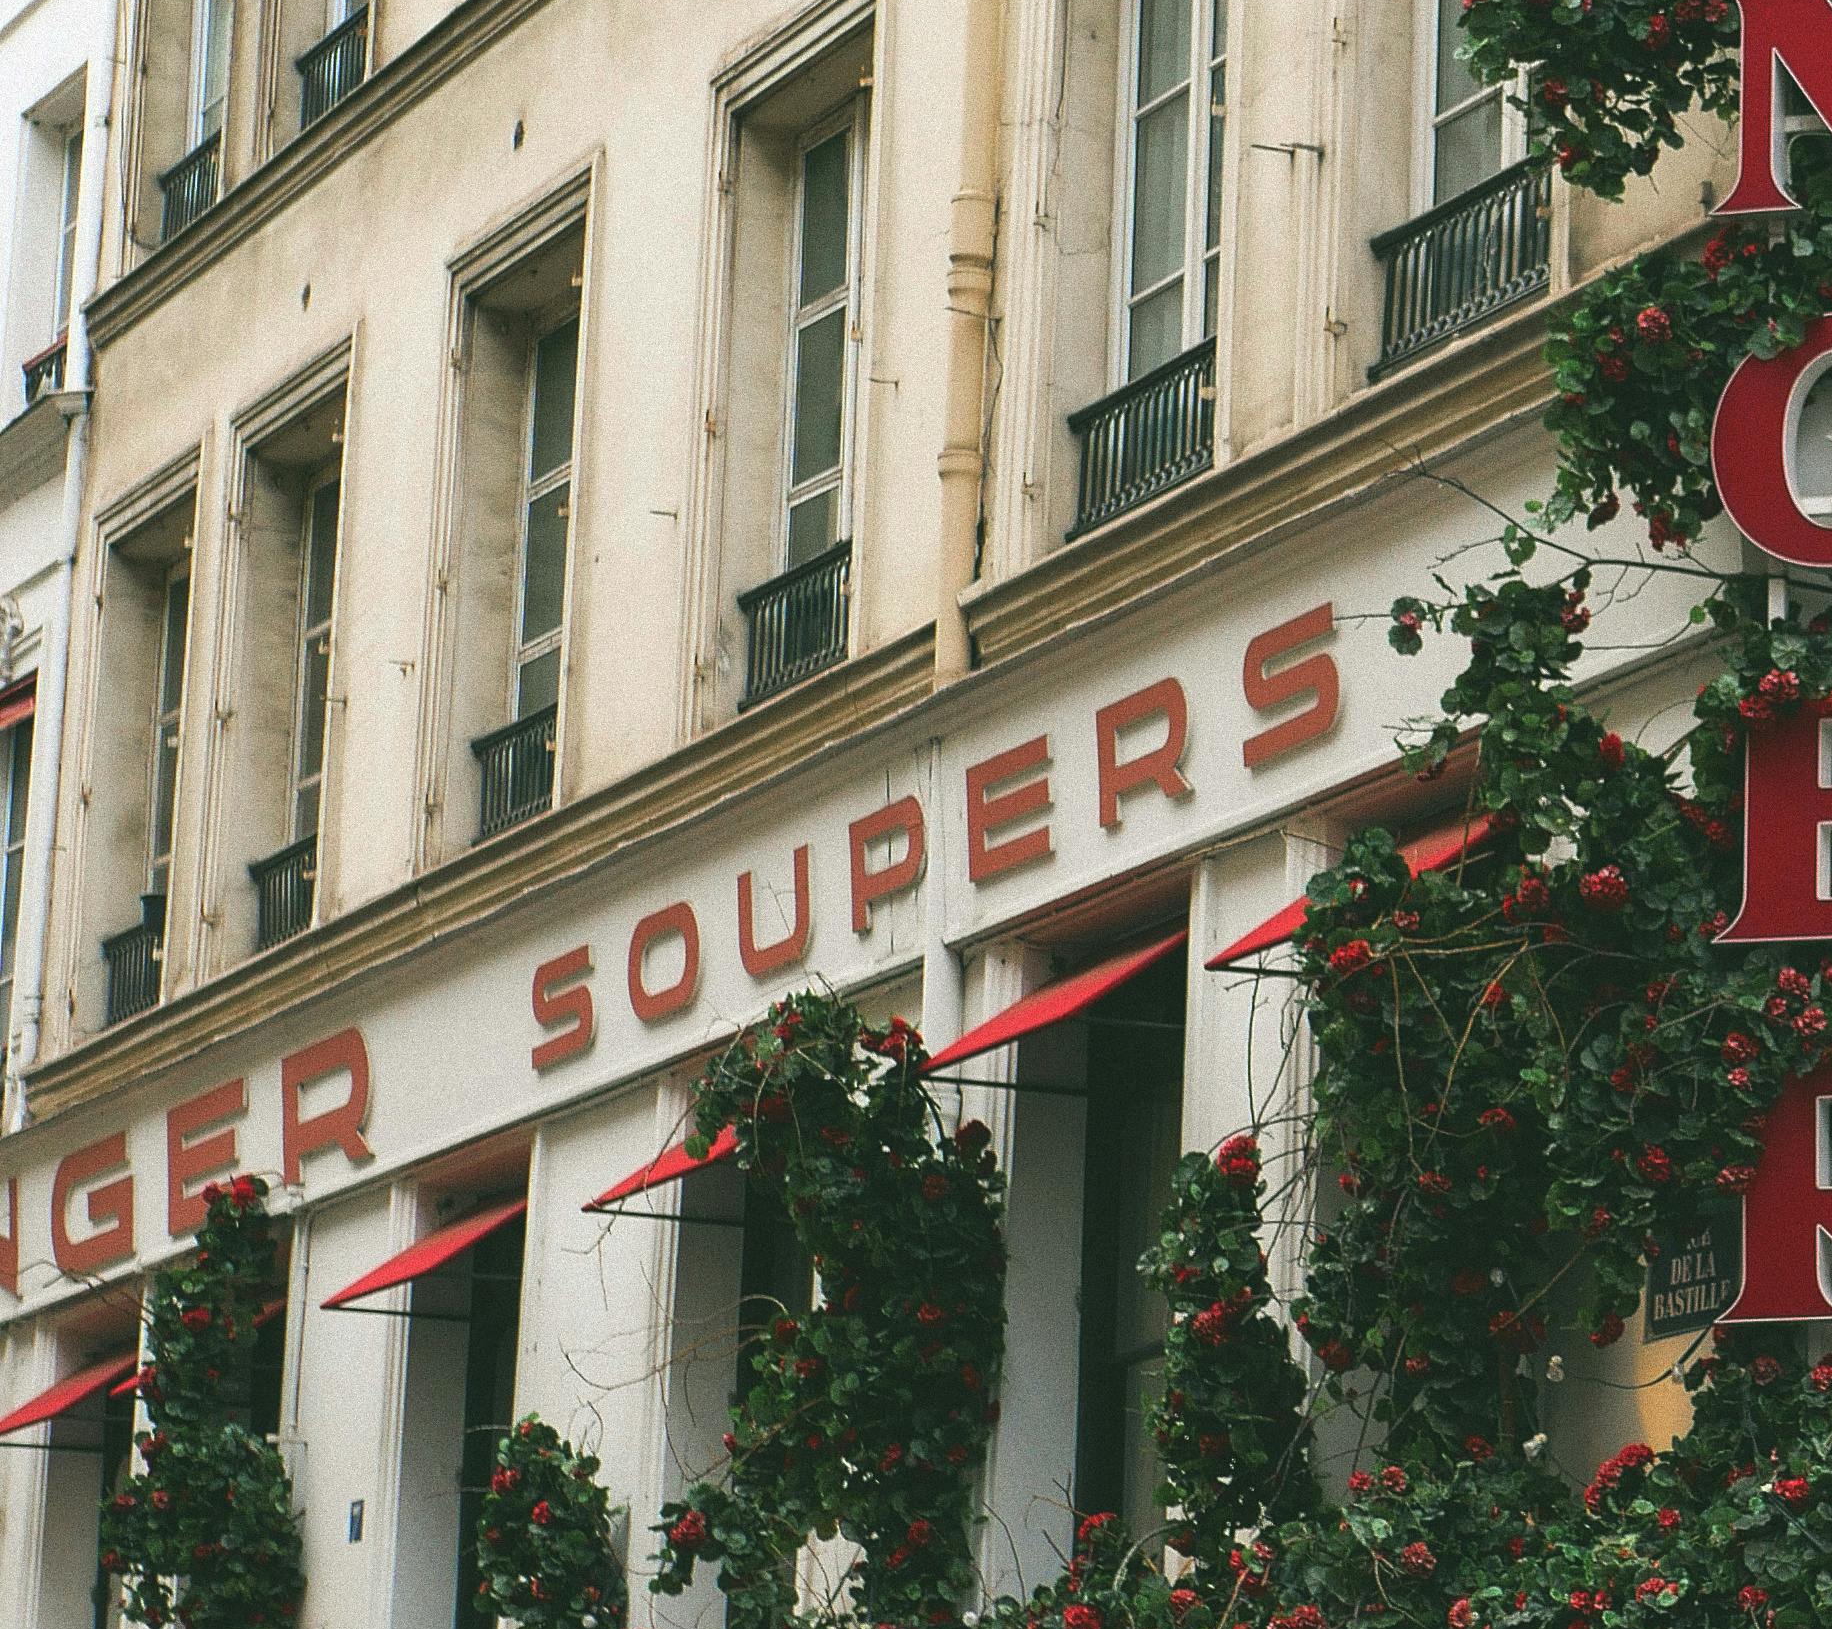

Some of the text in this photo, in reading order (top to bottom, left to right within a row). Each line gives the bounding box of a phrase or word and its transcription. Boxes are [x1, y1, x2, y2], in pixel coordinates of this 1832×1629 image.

[530, 601, 1341, 1071] SOUPERS
[1670, 1251, 1717, 1285] DE LA
